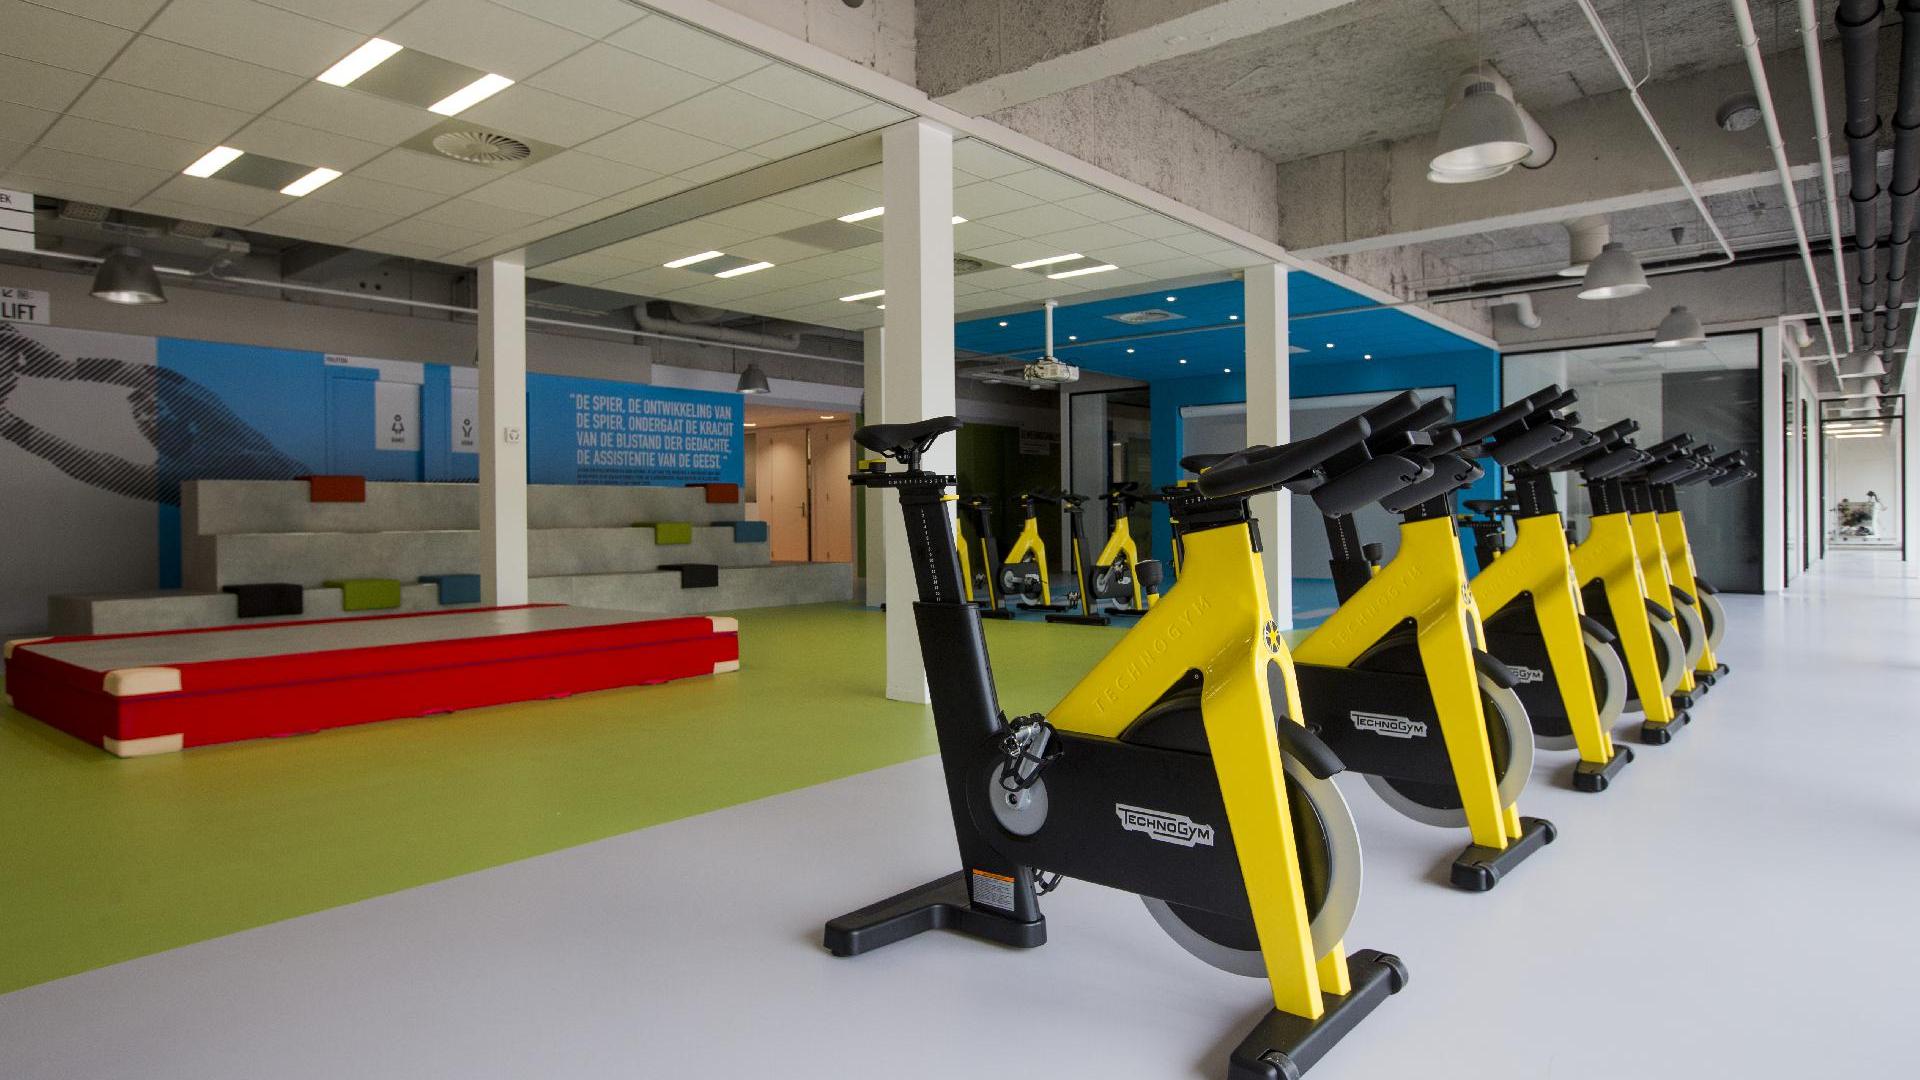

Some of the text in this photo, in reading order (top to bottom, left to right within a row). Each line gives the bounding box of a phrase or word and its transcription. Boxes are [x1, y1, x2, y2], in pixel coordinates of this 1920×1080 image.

[2, 302, 37, 320] LIFT
[628, 398, 641, 413] DE
[643, 399, 712, 419] ONTWIKKELING
[714, 405, 732, 420] VAN
[576, 412, 590, 428] DE
[628, 415, 683, 433] ONDERGAAT
[686, 419, 699, 434] DE
[700, 420, 734, 437] KRACHT
[576, 431, 597, 447] VAN
[600, 432, 613, 448] DE
[616, 433, 661, 449] BIJSTAND
[664, 435, 683, 450] DER
[576, 449, 590, 465] DE
[593, 449, 656, 467] ASSISTENTIE
[658, 452, 676, 468] VAN
[679, 453, 691, 468] DE
